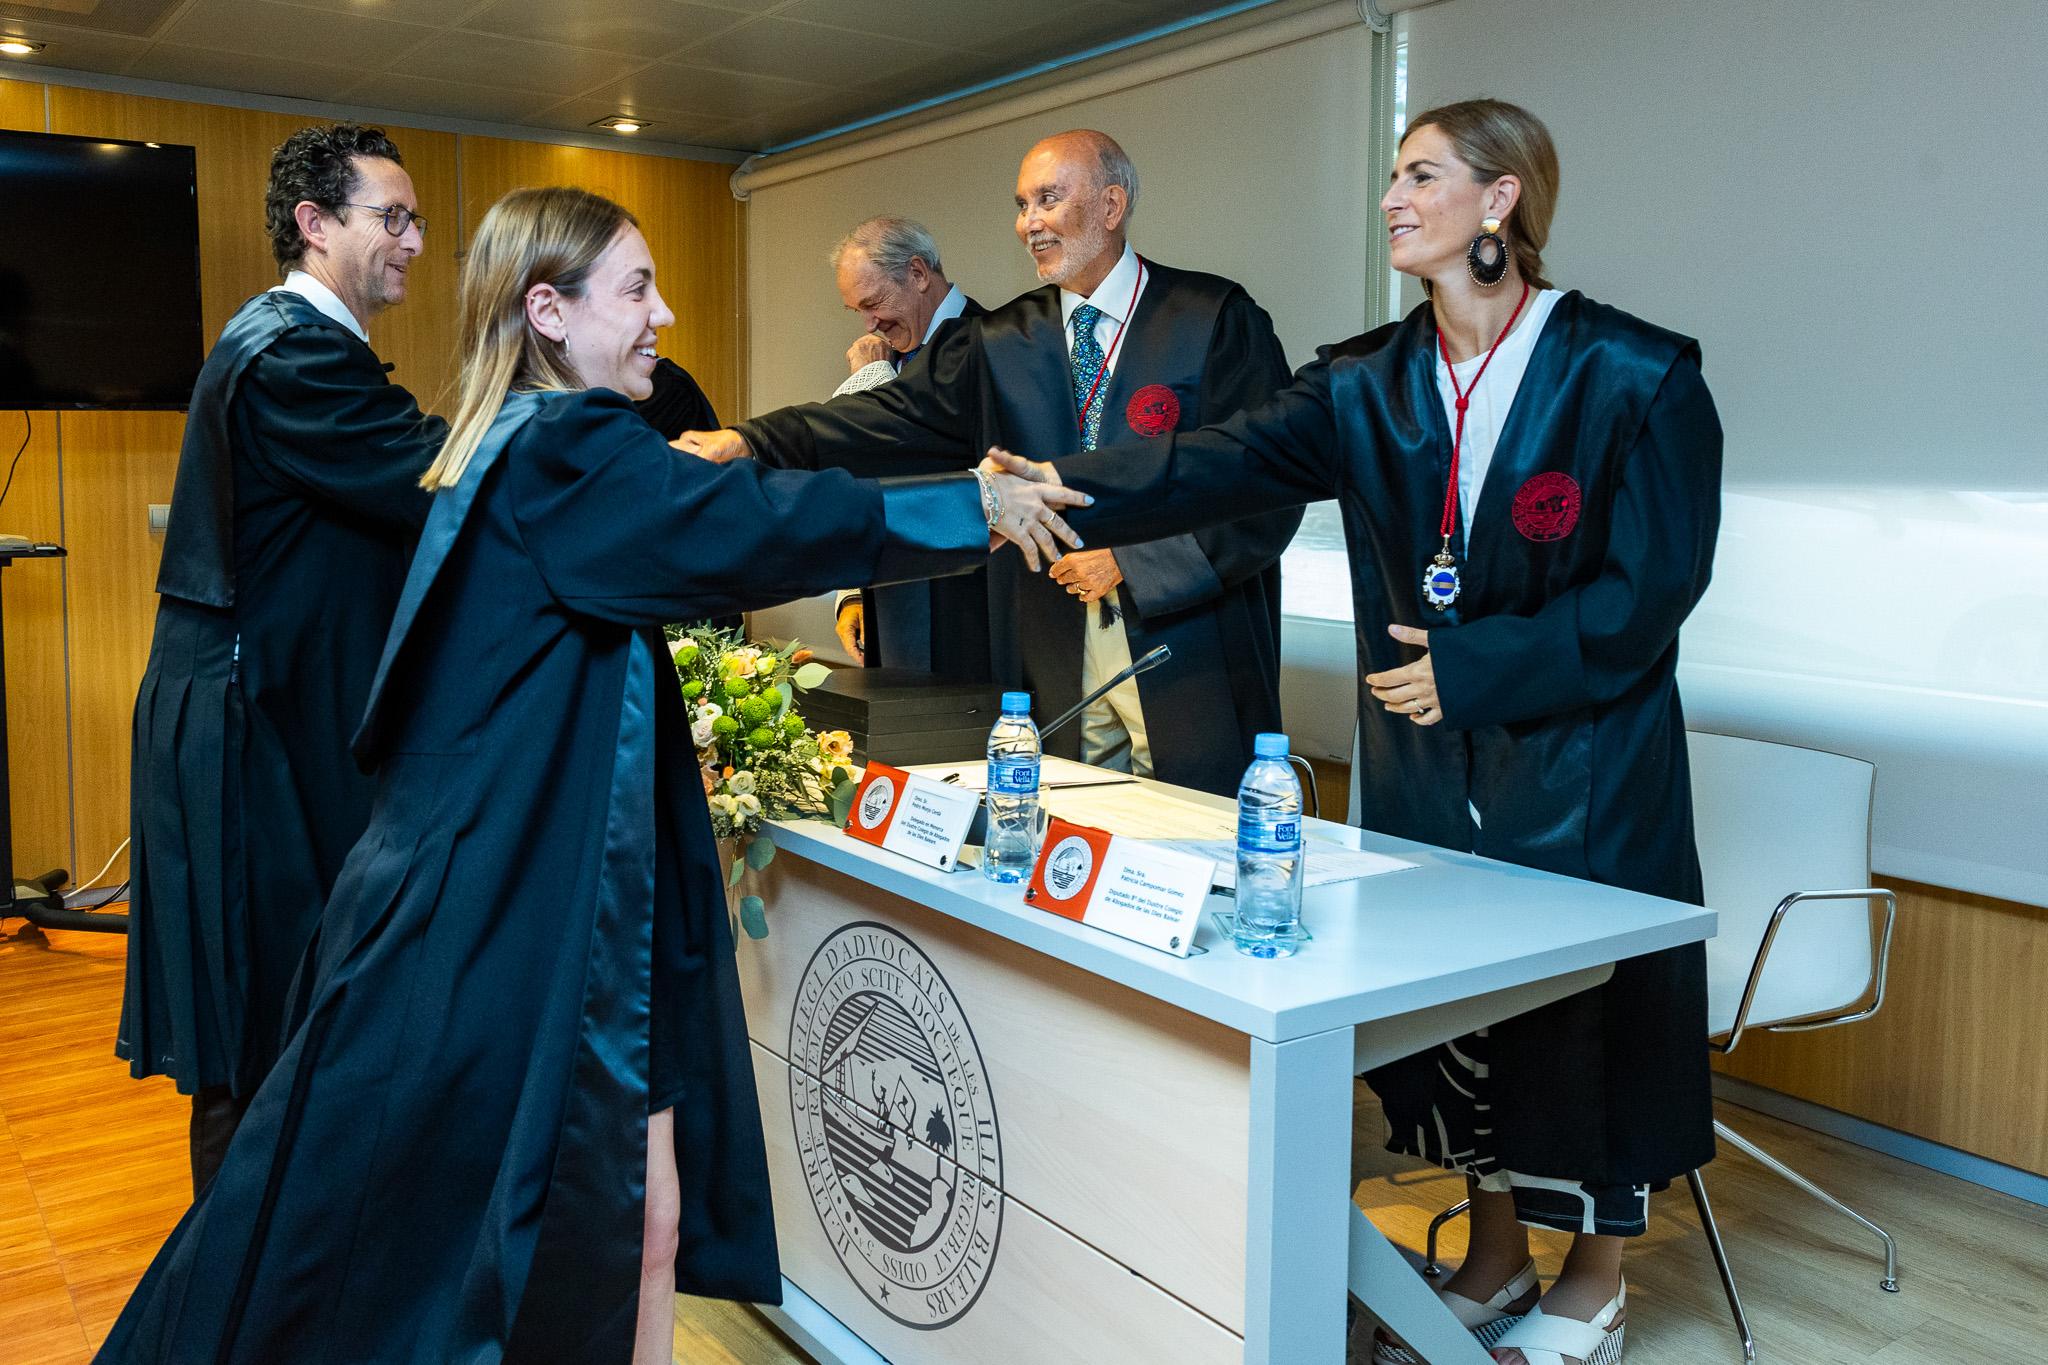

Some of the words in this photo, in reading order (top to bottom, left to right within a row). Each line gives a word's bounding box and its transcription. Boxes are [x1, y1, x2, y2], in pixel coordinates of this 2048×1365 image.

[1121, 875, 1139, 884] Patricia
[1112, 898, 1135, 909] Abogados
[824, 934, 948, 1014] D'ADVOCATS
[861, 967, 904, 999] SCITE
[947, 1021, 963, 1049] DE
[808, 1030, 821, 1116] RAEM
[911, 995, 975, 1151] DOCTEQUE
[963, 1059, 979, 1095] LES
[882, 1253, 927, 1284] ODISS
[925, 1230, 990, 1318] BALEARS
